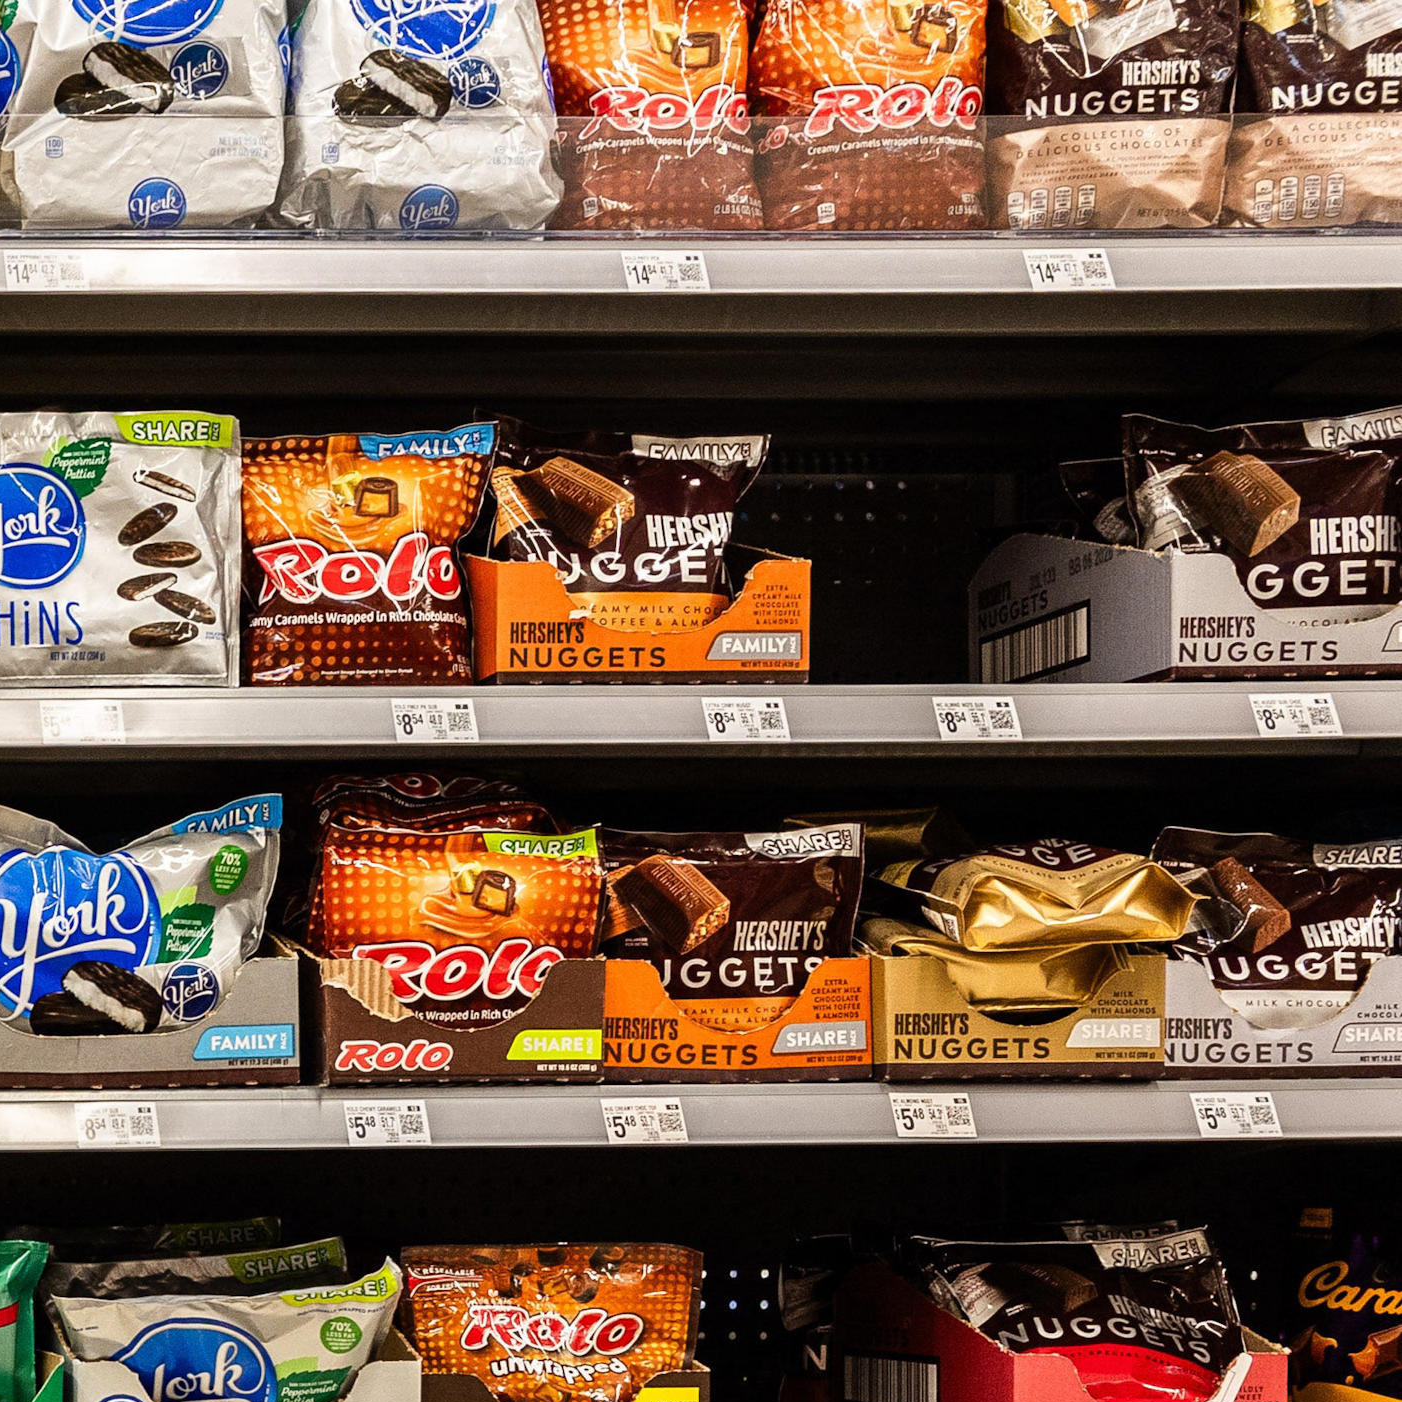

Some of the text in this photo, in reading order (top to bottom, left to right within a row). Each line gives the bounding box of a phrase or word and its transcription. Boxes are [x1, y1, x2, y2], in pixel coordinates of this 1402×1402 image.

[171, 55, 224, 92] York
[1122, 60, 1200, 86] HERSHEY'S
[587, 78, 753, 137] Rolo
[1024, 89, 1199, 116] NUGGETS
[1163, 127, 1181, 138] OF
[130, 192, 183, 223] York
[132, 420, 209, 441] SHARE
[53, 454, 107, 470] Peppermint
[64, 464, 96, 479] Patties
[260, 532, 462, 602] Rolo
[275, 610, 373, 625] Caramels Wrapped
[1180, 616, 1254, 638] HERSHEY'S
[510, 621, 584, 644] HERSHEY'S
[510, 648, 666, 668] NUGGETS
[1179, 641, 1338, 661] NUGGETS
[220, 851, 241, 866] 70%
[229, 866, 241, 874] FAT
[734, 921, 827, 952] HERSHEY'S
[211, 1035, 278, 1050] FAMILY
[1082, 1025, 1142, 1040] SHARE
[335, 1040, 450, 1071] Rolo
[895, 1038, 1049, 1060] NUGGETS
[490, 1357, 626, 1384] unwrapped
